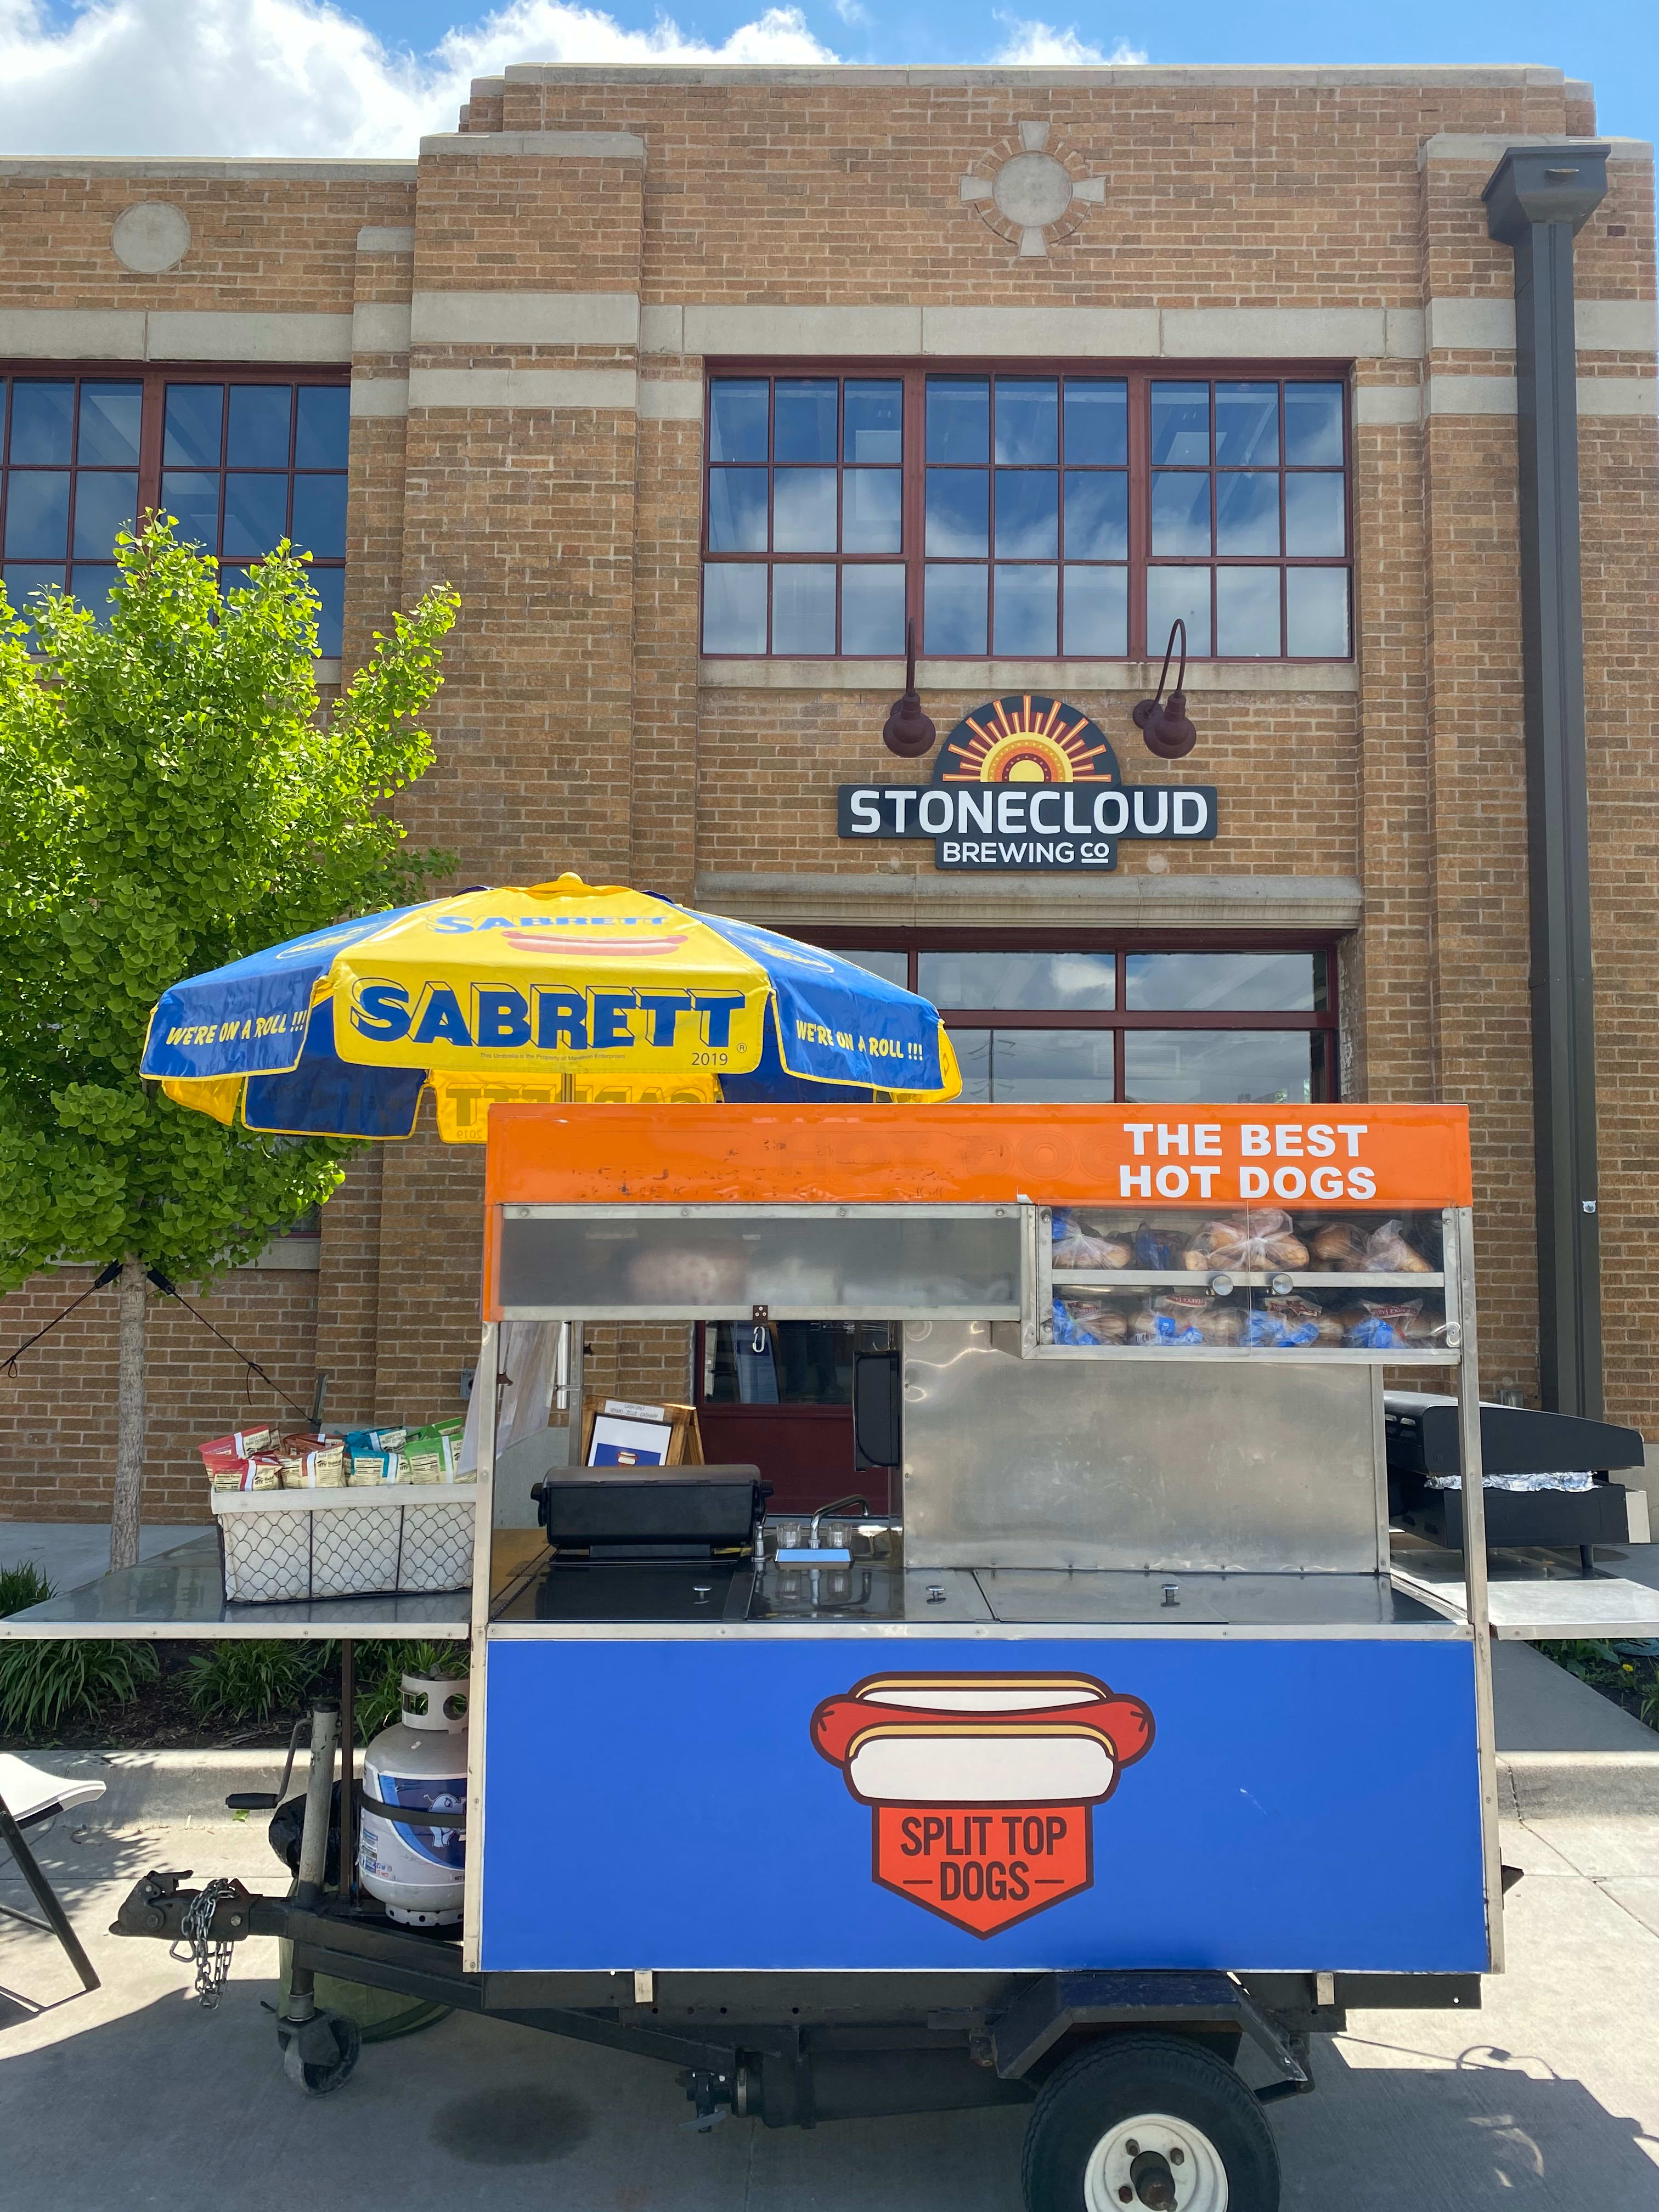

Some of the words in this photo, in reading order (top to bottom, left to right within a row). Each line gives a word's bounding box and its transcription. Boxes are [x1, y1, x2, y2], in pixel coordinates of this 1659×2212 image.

[850, 790, 1208, 835] STONECLOUD
[943, 842, 1075, 864] BREWING
[1081, 843, 1109, 863] CO
[426, 913, 667, 934] SABRETT
[166, 1025, 218, 1045] WE'RE
[219, 1021, 240, 1042] ON
[241, 1019, 251, 1040] A
[254, 1014, 287, 1038] ROLL
[351, 978, 746, 1050] SABRETT
[796, 1019, 834, 1046] WE'RE
[836, 1031, 854, 1051] ON
[858, 1035, 867, 1053] A
[869, 1037, 904, 1058] ROLL
[692, 1052, 728, 1066] 2019
[1124, 1124, 1222, 1156] THE
[1241, 1124, 1369, 1158] BEST
[1120, 1165, 1221, 1198] HOT
[1239, 1166, 1377, 1200] DOGS
[901, 1816, 993, 1856] SPLIT
[1002, 1816, 1067, 1855] TOP
[940, 1861, 1030, 1901] DOGS
